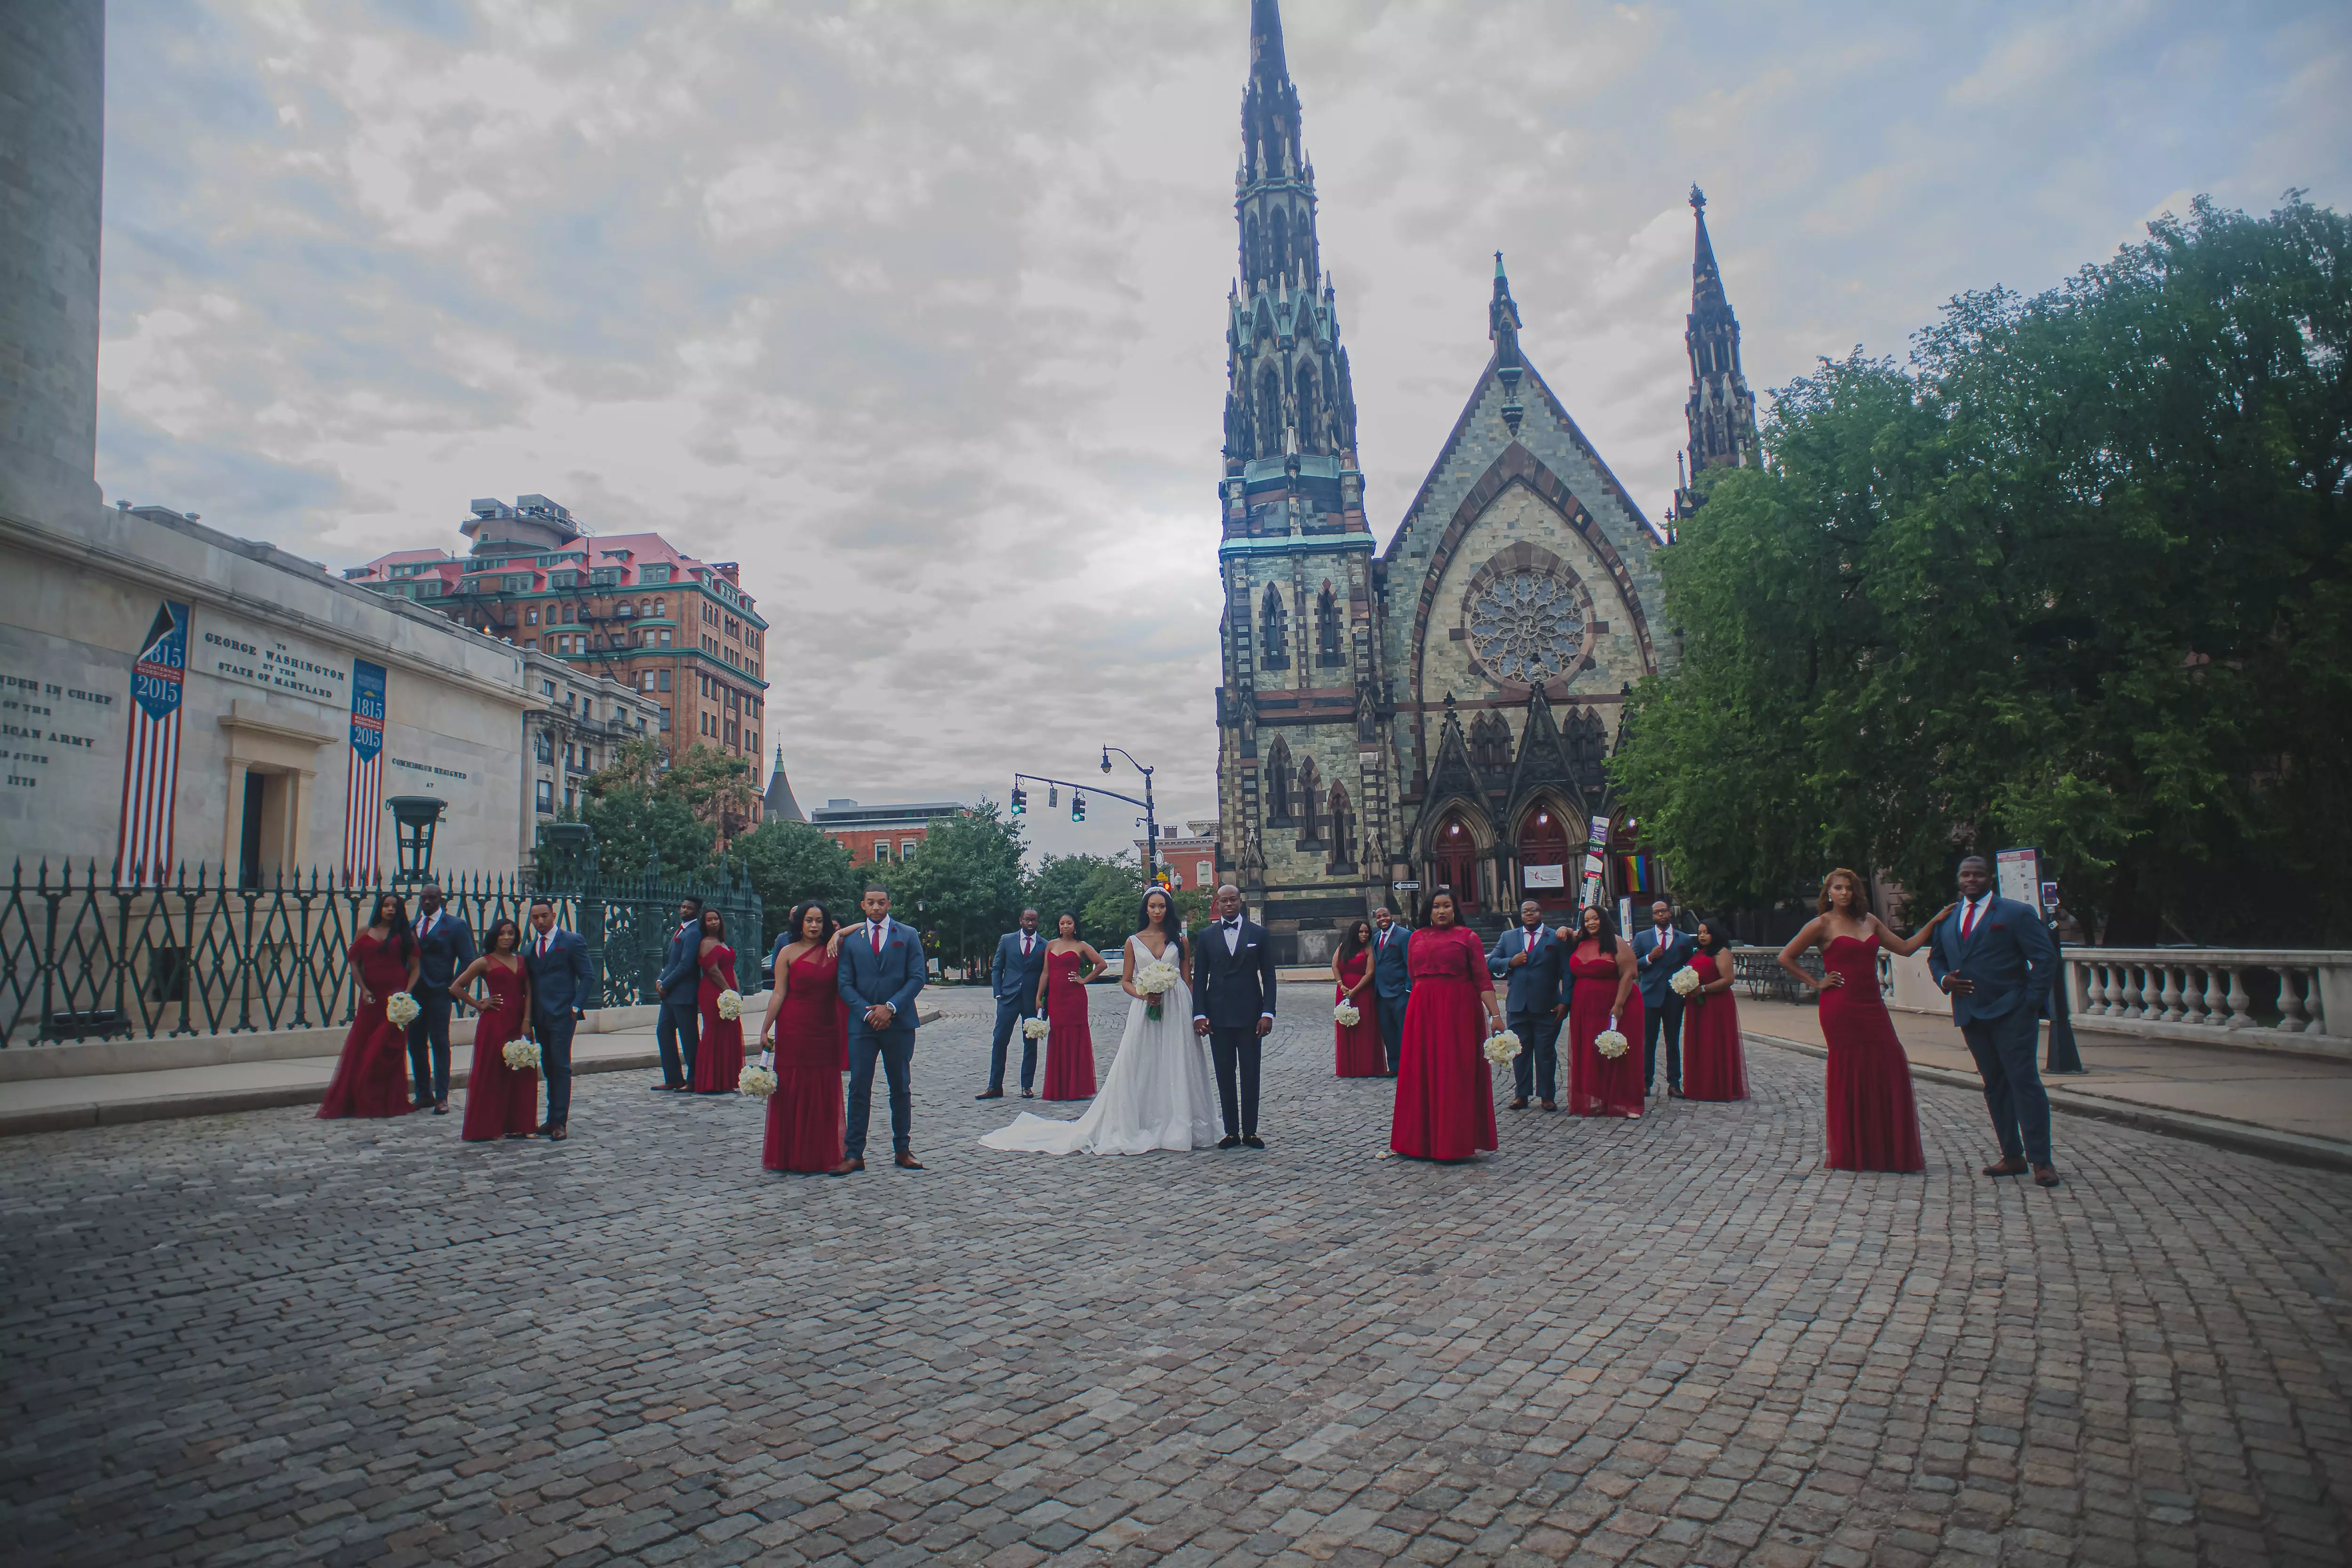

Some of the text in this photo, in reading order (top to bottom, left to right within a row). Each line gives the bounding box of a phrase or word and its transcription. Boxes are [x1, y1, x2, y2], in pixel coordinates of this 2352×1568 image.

[150, 644, 182, 668] 815
[205, 632, 345, 681] GEORGE WASHINGTON
[218, 662, 332, 698] STATE OF MARYLAND
[262, 663, 296, 677] BY THE
[45, 684, 63, 695] IN
[68, 689, 112, 705] CHIEF
[137, 675, 177, 702] 2015
[23, 704, 51, 716] THE
[356, 697, 382, 719] 1815
[48, 732, 95, 748] ARMY
[354, 726, 380, 748] 2015
[434, 767, 467, 779] RESIGNED
